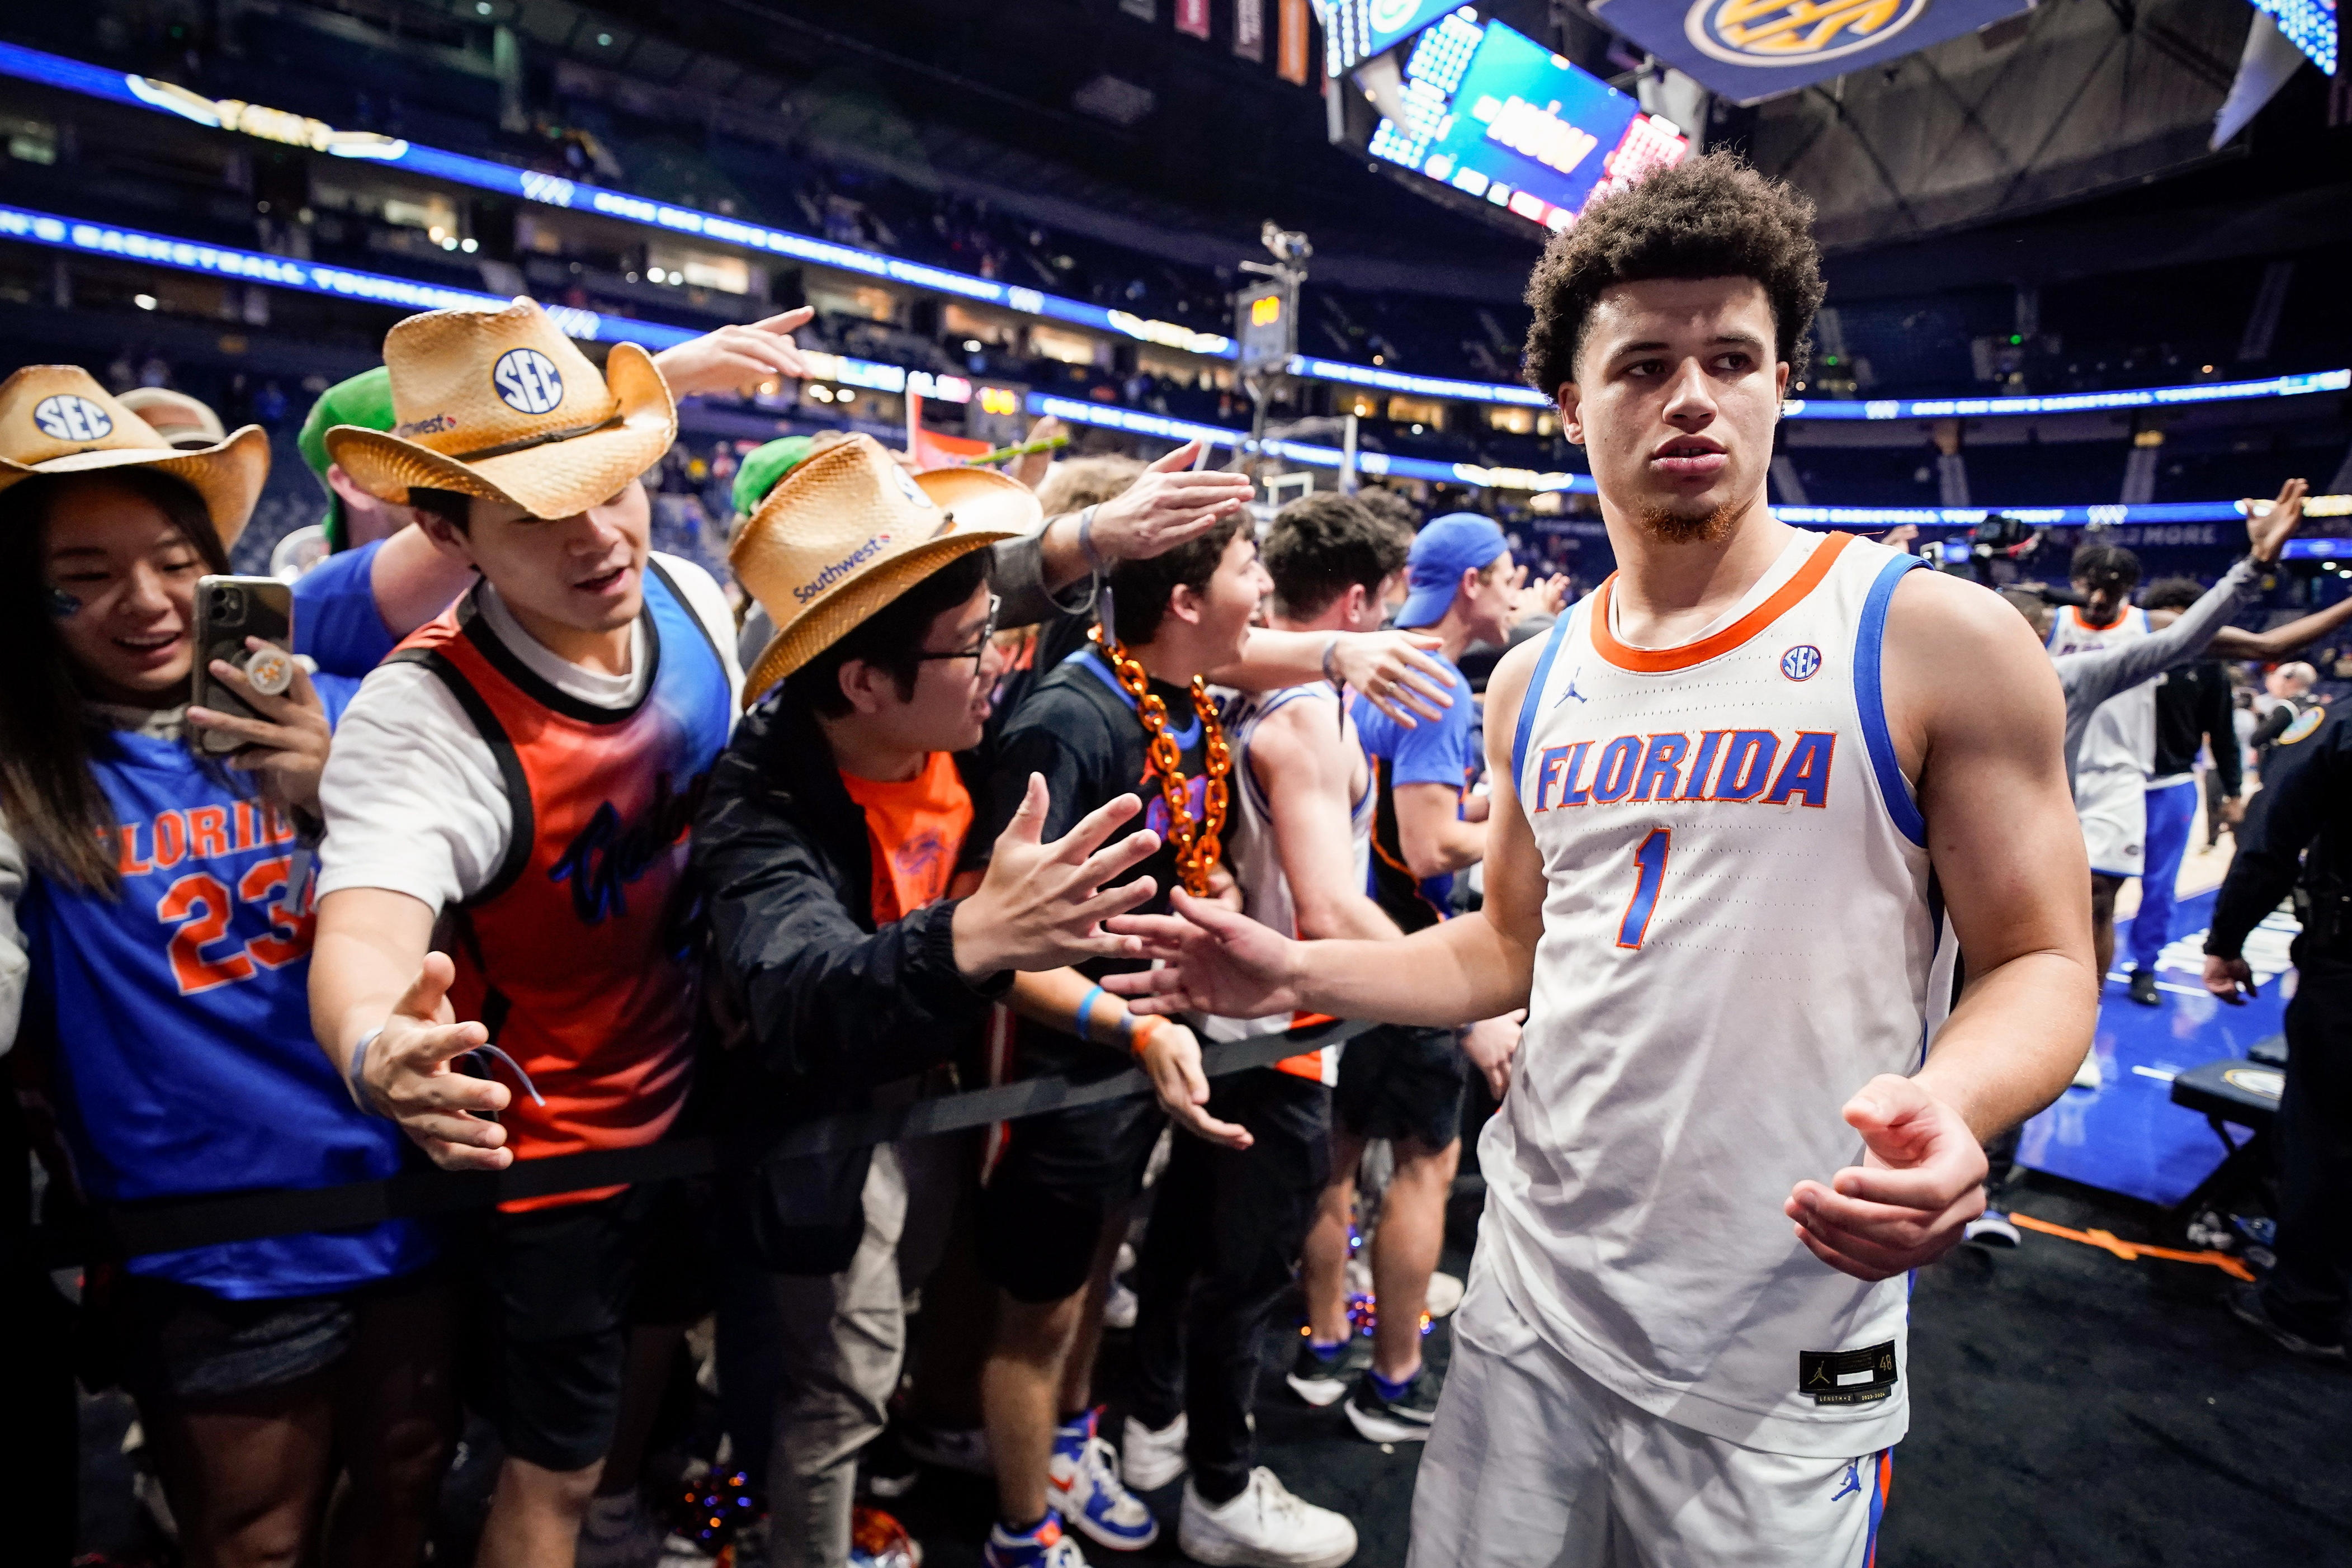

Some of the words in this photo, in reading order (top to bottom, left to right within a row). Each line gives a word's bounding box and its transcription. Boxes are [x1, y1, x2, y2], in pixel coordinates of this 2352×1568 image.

[495, 349, 563, 414] SEC
[35, 394, 111, 440] SEC
[793, 539, 881, 604] Southwest
[1782, 646, 1820, 678] SEC
[1534, 729, 1838, 813] FLORIDA
[1616, 828, 1671, 950] 1
[157, 855, 317, 996] 23
[1879, 1354, 1892, 1371] 48
